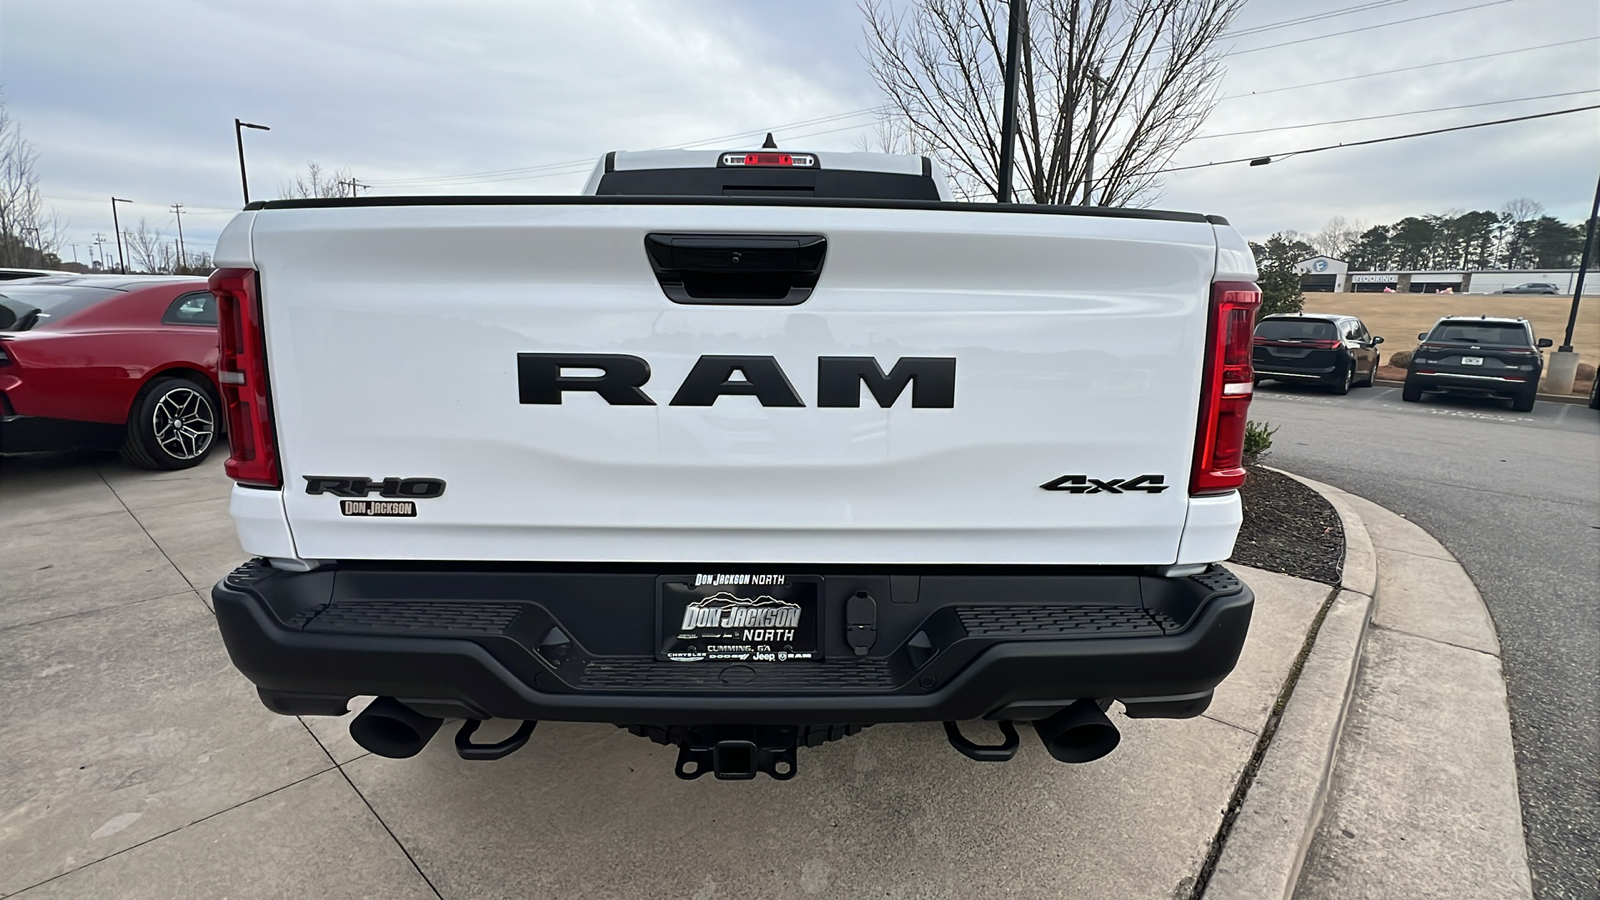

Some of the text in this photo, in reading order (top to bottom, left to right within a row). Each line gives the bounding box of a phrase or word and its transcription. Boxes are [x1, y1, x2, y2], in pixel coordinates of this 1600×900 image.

[1355, 275, 1395, 283] FLOORING
[517, 352, 956, 409] RAM
[302, 475, 447, 498] RHO
[1039, 474, 1169, 493] 4x4
[345, 501, 412, 516] DON JACKSON
[695, 574, 785, 586] DON JACKSON NORTH
[681, 606, 801, 630] DON JACKSON
[743, 629, 795, 641] NORTH
[753, 652, 775, 662] Jeep
